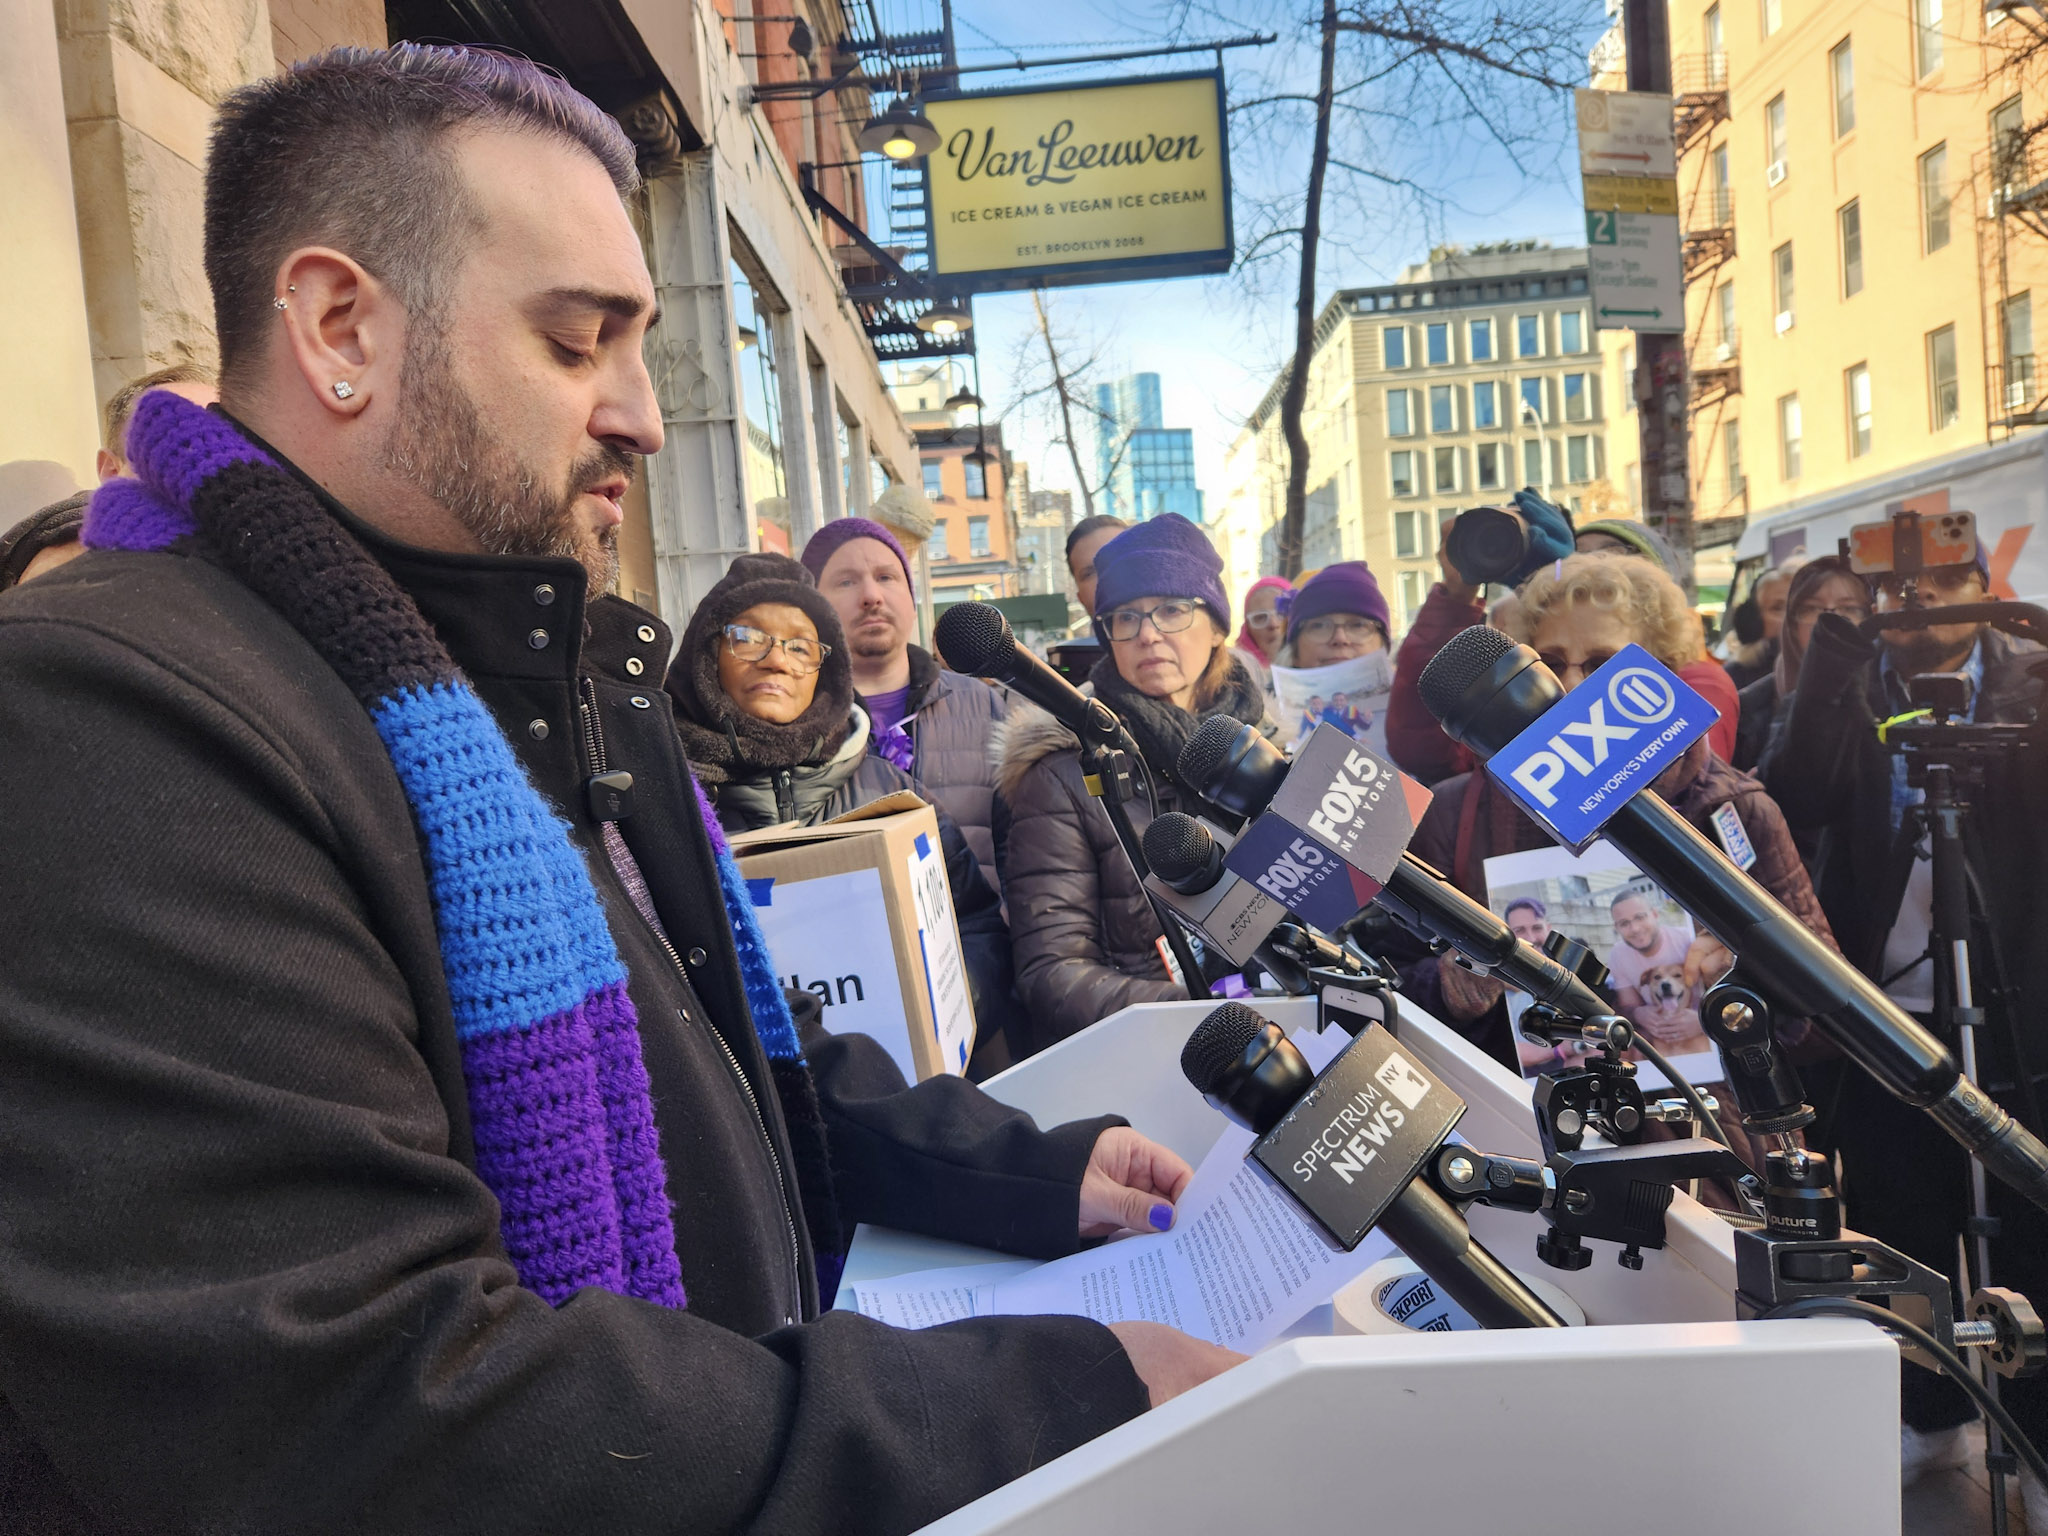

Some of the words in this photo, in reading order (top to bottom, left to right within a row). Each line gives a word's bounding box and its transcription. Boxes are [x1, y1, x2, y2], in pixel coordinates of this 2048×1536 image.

[948, 127, 1036, 181] Van
[1026, 119, 1203, 186] Leeuwen
[952, 210, 976, 224] ICE
[983, 204, 1039, 221] CREAM
[1045, 203, 1055, 215] &
[1059, 197, 1112, 213] VEGAN
[1118, 194, 1144, 208] ICE
[1149, 189, 1207, 206] CREAM
[1593, 212, 1611, 241] 2
[1016, 246, 1042, 257] EST.
[1046, 239, 1111, 254] BROOKLYN
[1510, 697, 1641, 809] PIX
[1577, 790, 1606, 815] NEW
[1636, 738, 1666, 767] VERY
[1662, 718, 1689, 742] OWN
[1341, 817, 1366, 852] NEW
[1365, 770, 1393, 813] YORK
[1286, 888, 1309, 909] NEW
[1308, 860, 1340, 887] YORK
[1227, 915, 1252, 946] NEW
[1234, 909, 1248, 924] CBS
[1381, 1064, 1401, 1086] NY
[1407, 1069, 1425, 1088] 1
[1293, 1082, 1383, 1183] SPECTRUM
[1330, 1100, 1405, 1185] NEWS
[1391, 1278, 1434, 1321] CKPORT
[1426, 1312, 1453, 1331] ORT
